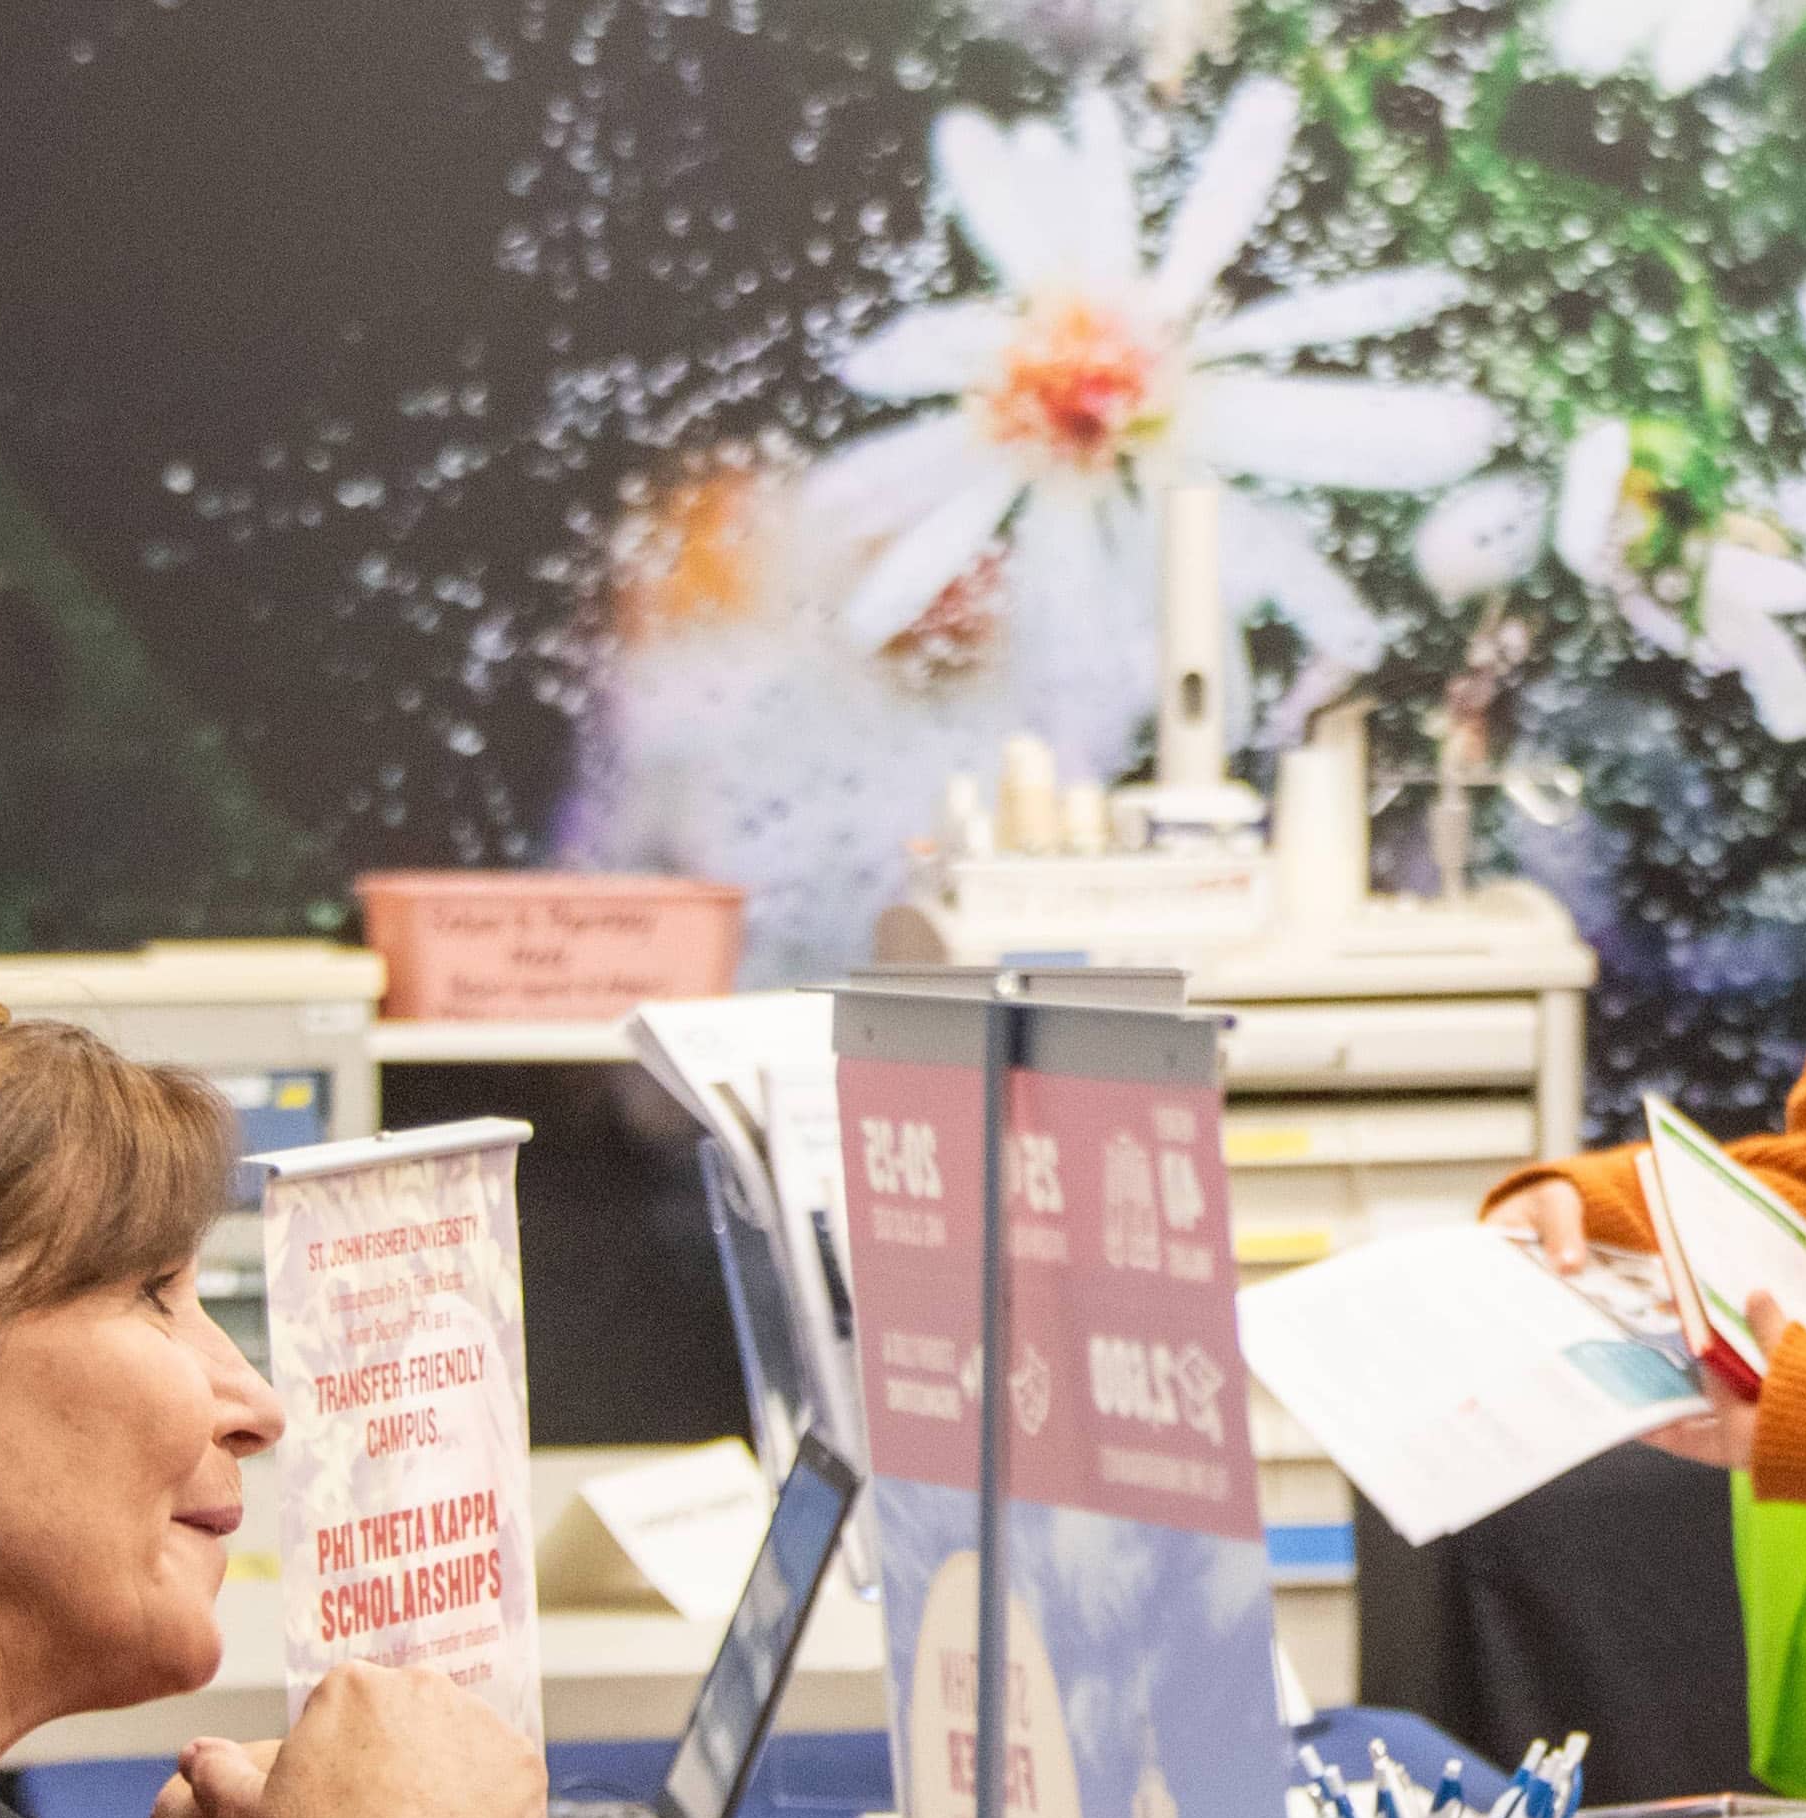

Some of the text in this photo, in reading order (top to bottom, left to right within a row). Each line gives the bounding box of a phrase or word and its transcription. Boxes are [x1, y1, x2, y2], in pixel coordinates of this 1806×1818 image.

[308, 1214, 479, 1271] ST. JOHN FISHER UNIVERSITY
[314, 1343, 486, 1416] TRANSFER-FRIENDLY
[366, 1405, 443, 1459] CAMPUS.
[316, 1489, 500, 1577] PHI THETA KAPPA
[320, 1547, 504, 1643] SCHOLARSHIPS
